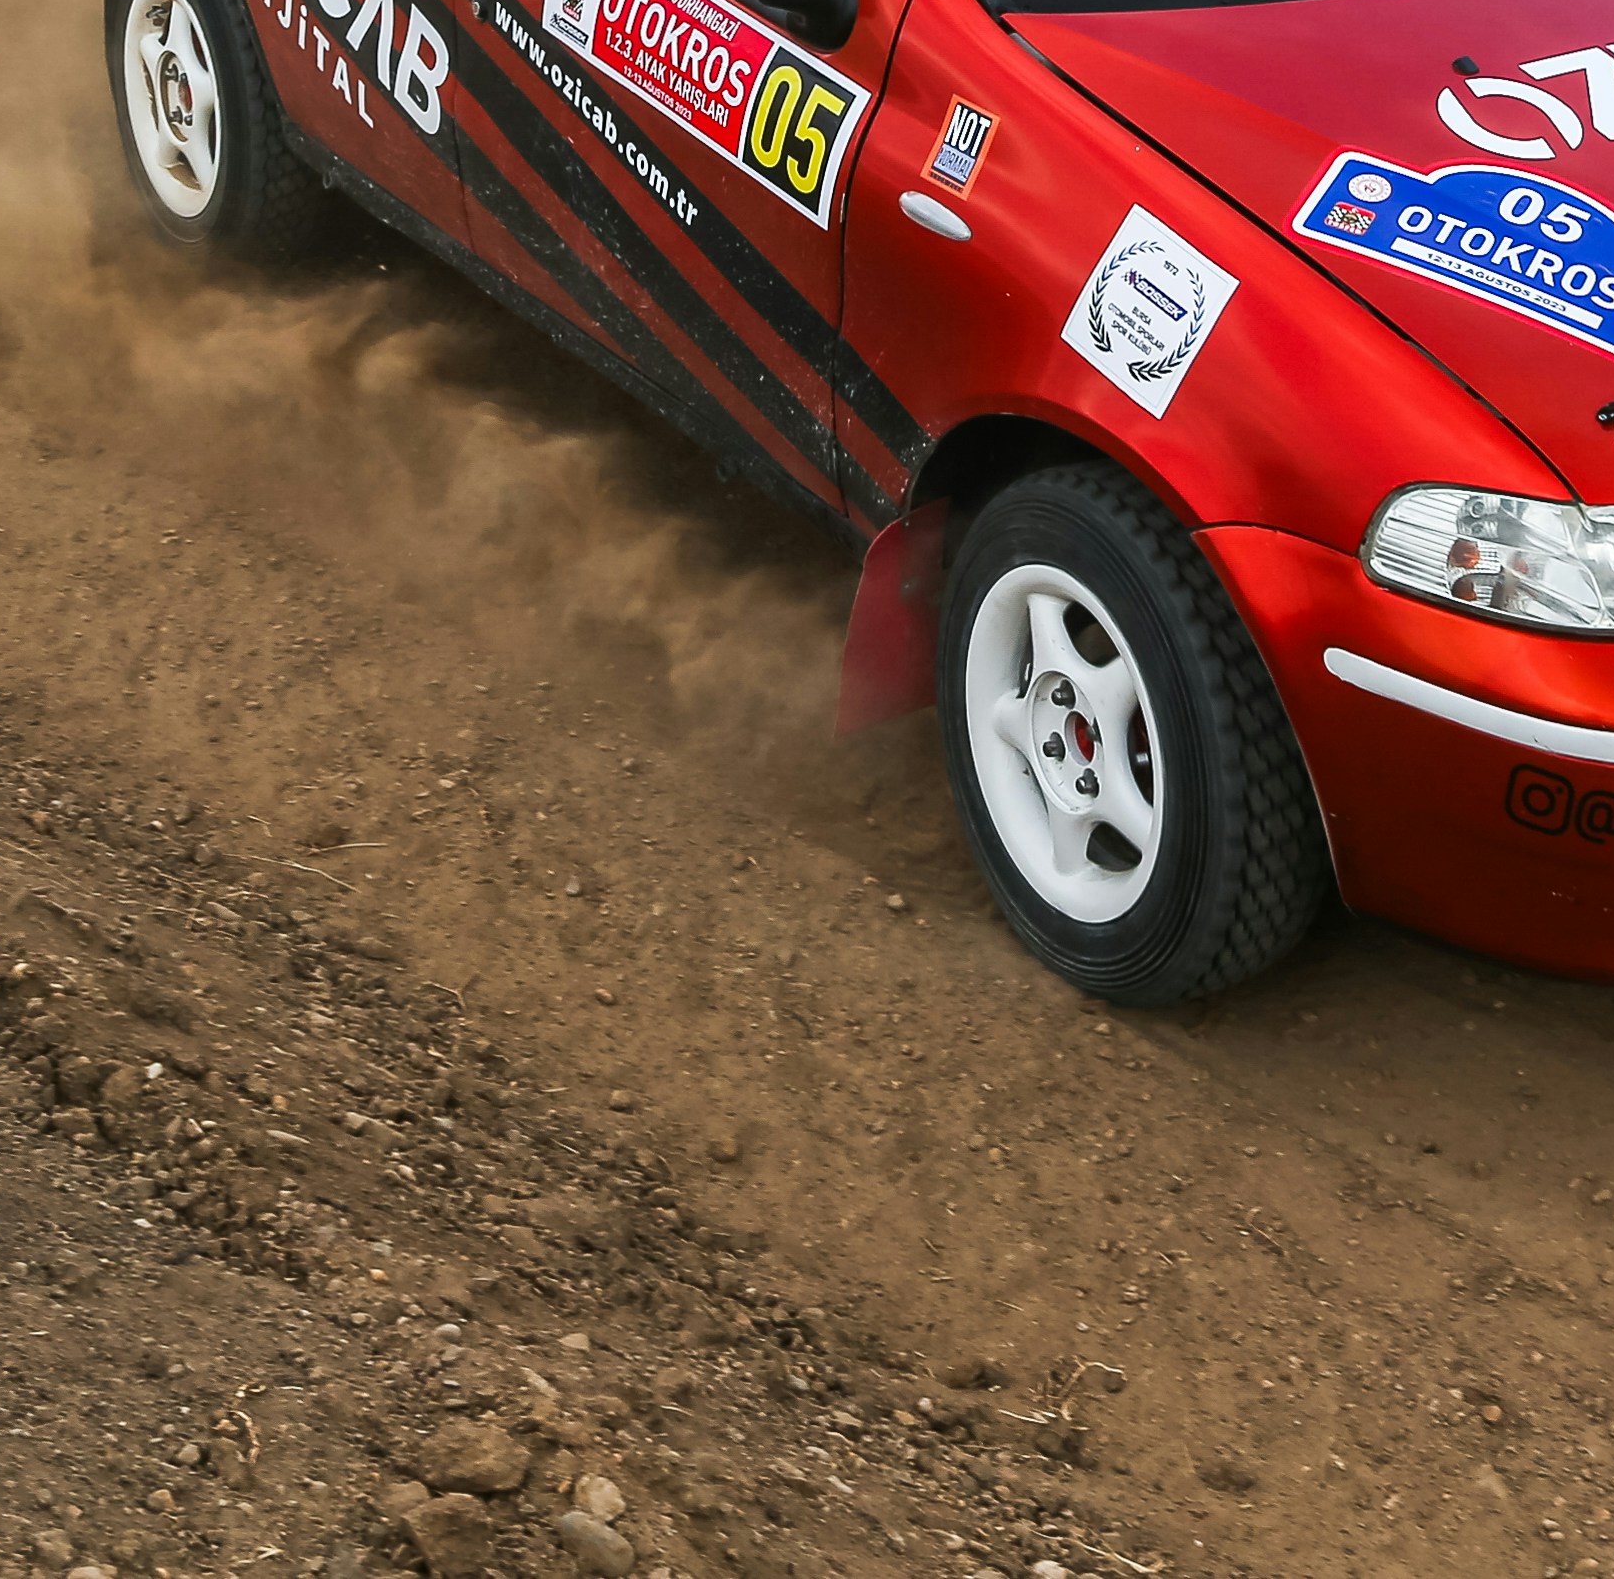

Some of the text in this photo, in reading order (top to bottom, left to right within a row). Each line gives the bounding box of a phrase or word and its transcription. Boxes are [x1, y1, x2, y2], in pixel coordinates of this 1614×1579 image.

[606, 26, 633, 61] 1.2.3.
[635, 49, 667, 83] AYAK
[669, 69, 729, 127] YARIŞLARI
[494, 1, 698, 226] www.ozicab.com.tr
[751, 66, 846, 194] 05
[944, 104, 991, 156] NOT
[936, 147, 973, 179] NORMAL
[1498, 187, 1592, 243] 05
[1135, 281, 1183, 319] BOSSEK
[1427, 253, 1461, 270] 12-13
[1534, 295, 1566, 312] 2023
